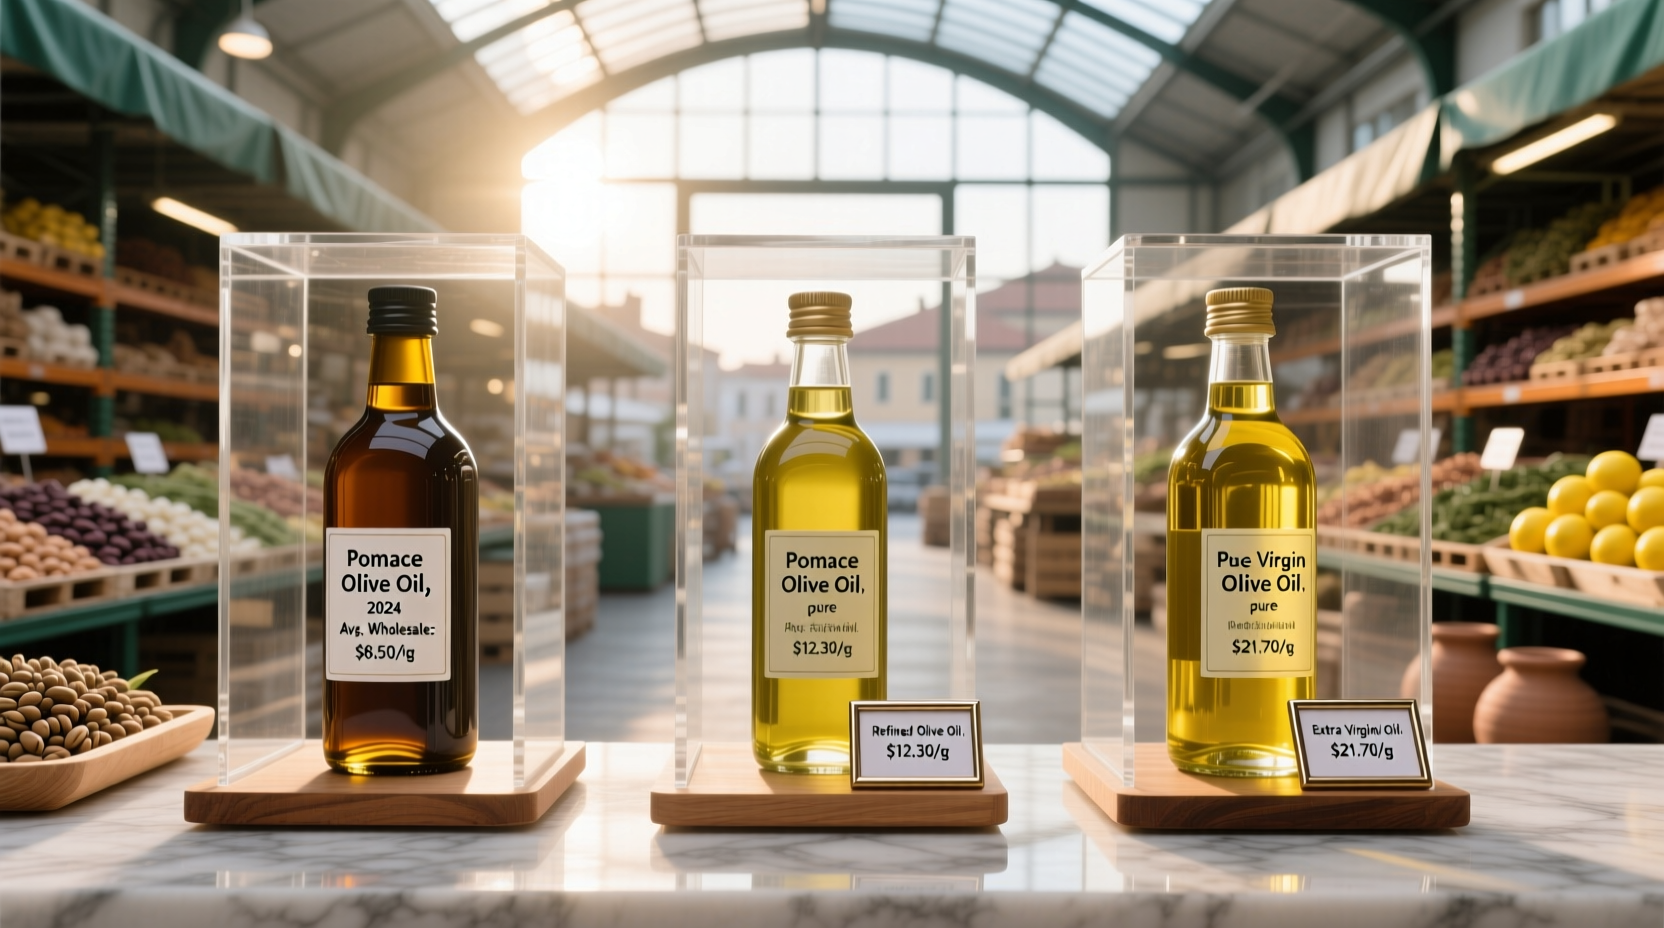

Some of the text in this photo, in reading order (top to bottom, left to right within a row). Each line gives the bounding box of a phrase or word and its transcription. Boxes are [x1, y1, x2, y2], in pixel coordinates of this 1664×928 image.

[347, 549, 423, 567] Pomace
[786, 551, 859, 569] Pomace
[1217, 551, 1306, 572] Pue Virgin
[341, 572, 431, 597] Olive Oil,
[781, 574, 865, 595] Olive Oil,
[1221, 573, 1272, 593] Olive
[367, 601, 402, 615] 2024
[808, 603, 837, 617] pure
[1250, 602, 1278, 615] pure
[793, 640, 853, 658] $12.30/g
[1232, 639, 1295, 657] $21.70/g
[917, 724, 944, 737] Olive
[886, 743, 950, 761] $12.30/g
[1331, 742, 1394, 761] $21.70/g
